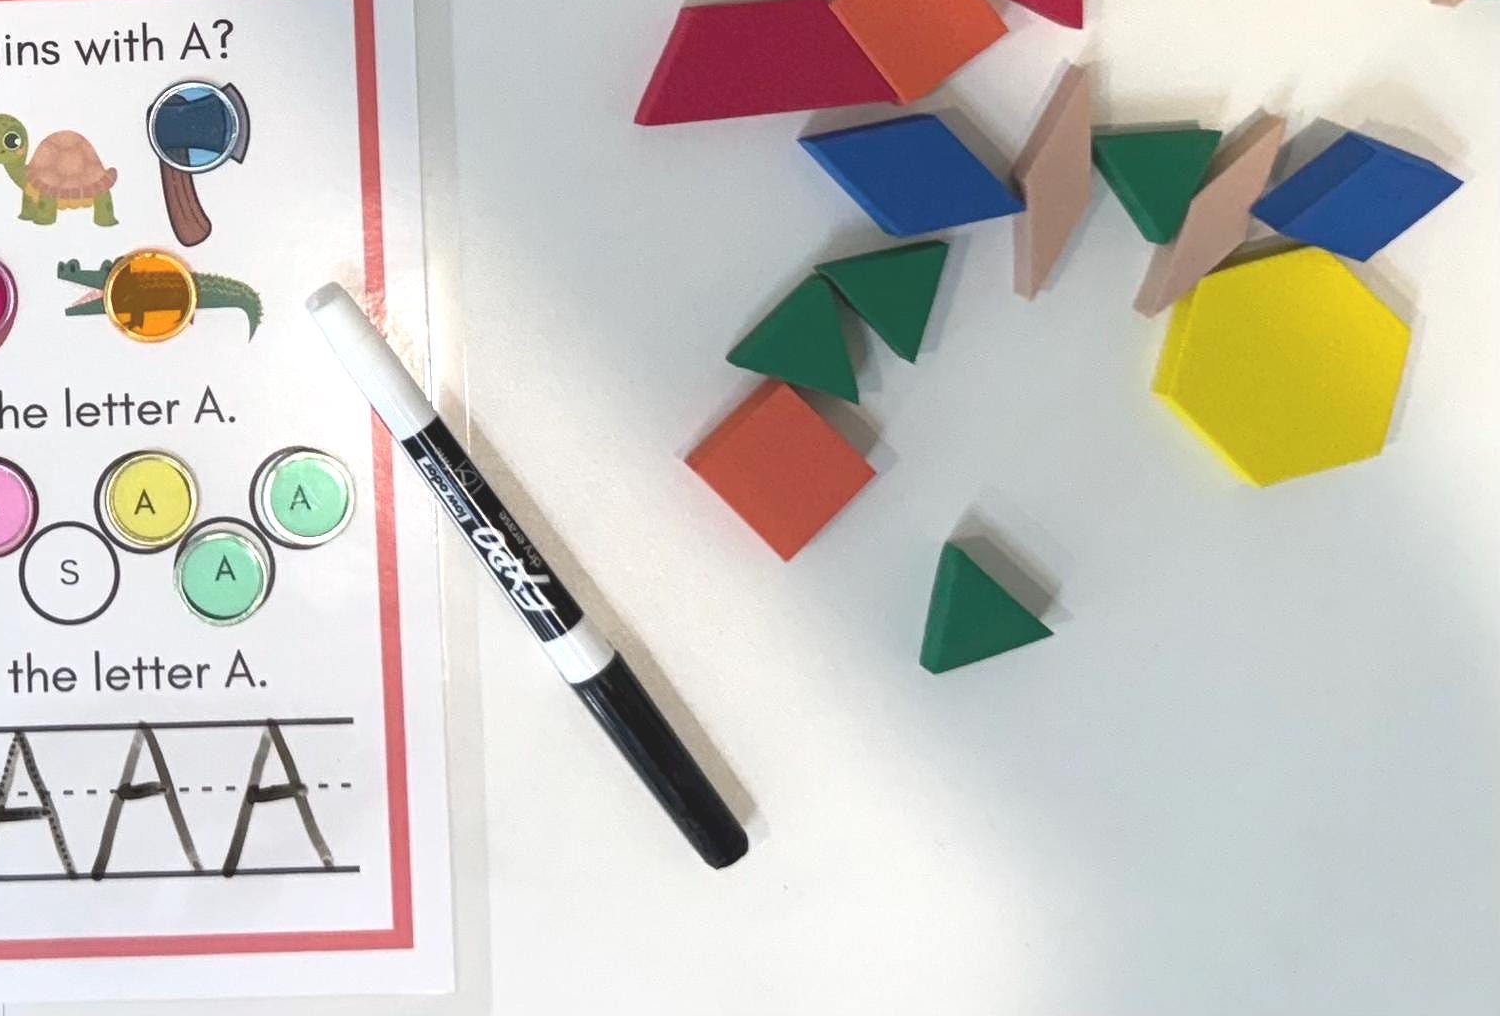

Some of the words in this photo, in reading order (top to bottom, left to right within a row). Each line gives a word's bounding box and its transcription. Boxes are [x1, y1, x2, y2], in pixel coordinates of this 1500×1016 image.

[74, 22, 163, 65] with
[180, 19, 233, 60] A?
[65, 387, 180, 427] letter
[194, 385, 235, 423] A.
[420, 460, 450, 495] odor
[134, 489, 155, 515] A
[290, 485, 311, 510] A
[443, 491, 467, 519] low
[61, 560, 79, 585] S
[216, 555, 236, 581] A
[522, 545, 543, 570] dry
[8, 652, 77, 693] the
[95, 651, 210, 691] letter
[225, 649, 266, 688] A.
[91, 719, 204, 882] A
[222, 718, 338, 878] A
